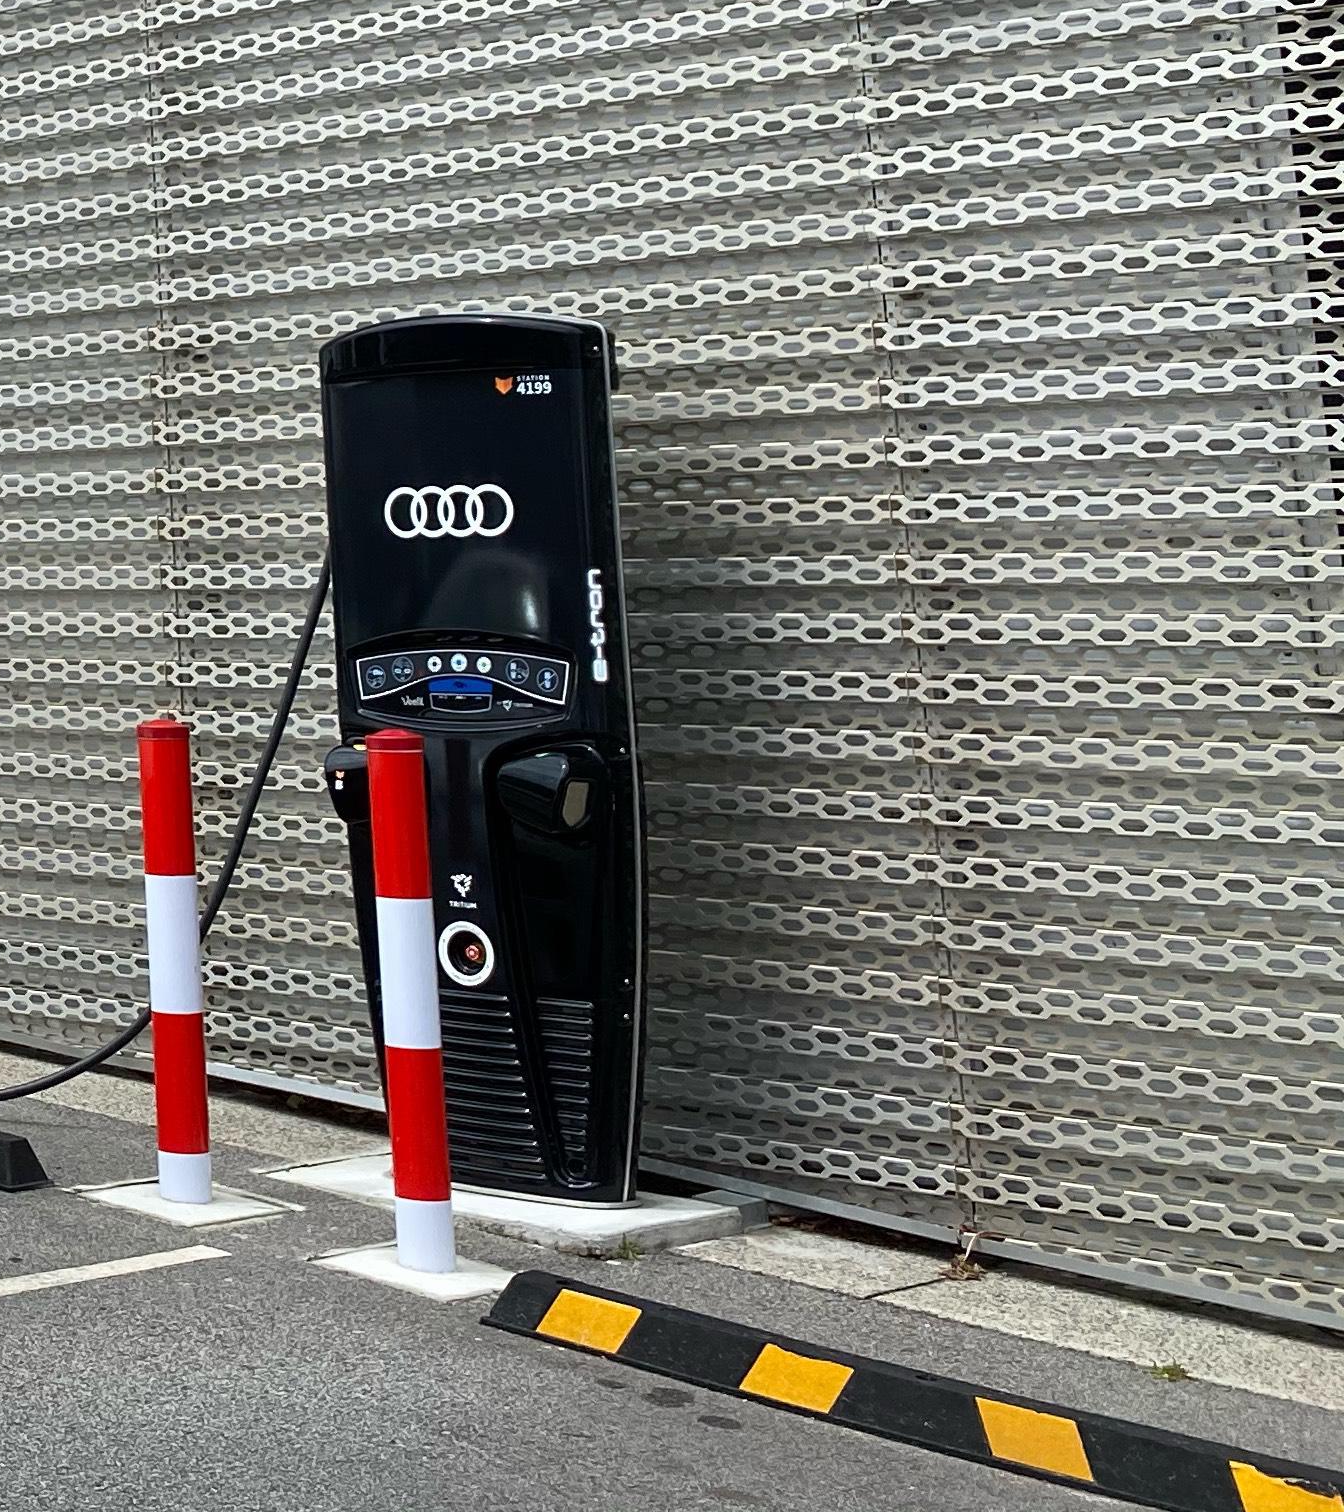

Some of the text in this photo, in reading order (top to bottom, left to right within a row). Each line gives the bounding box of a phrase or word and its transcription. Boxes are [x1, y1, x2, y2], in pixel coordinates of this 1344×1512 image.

[516, 374, 550, 382] STATION
[516, 381, 552, 395] 4199
[588, 569, 609, 682] e-tron
